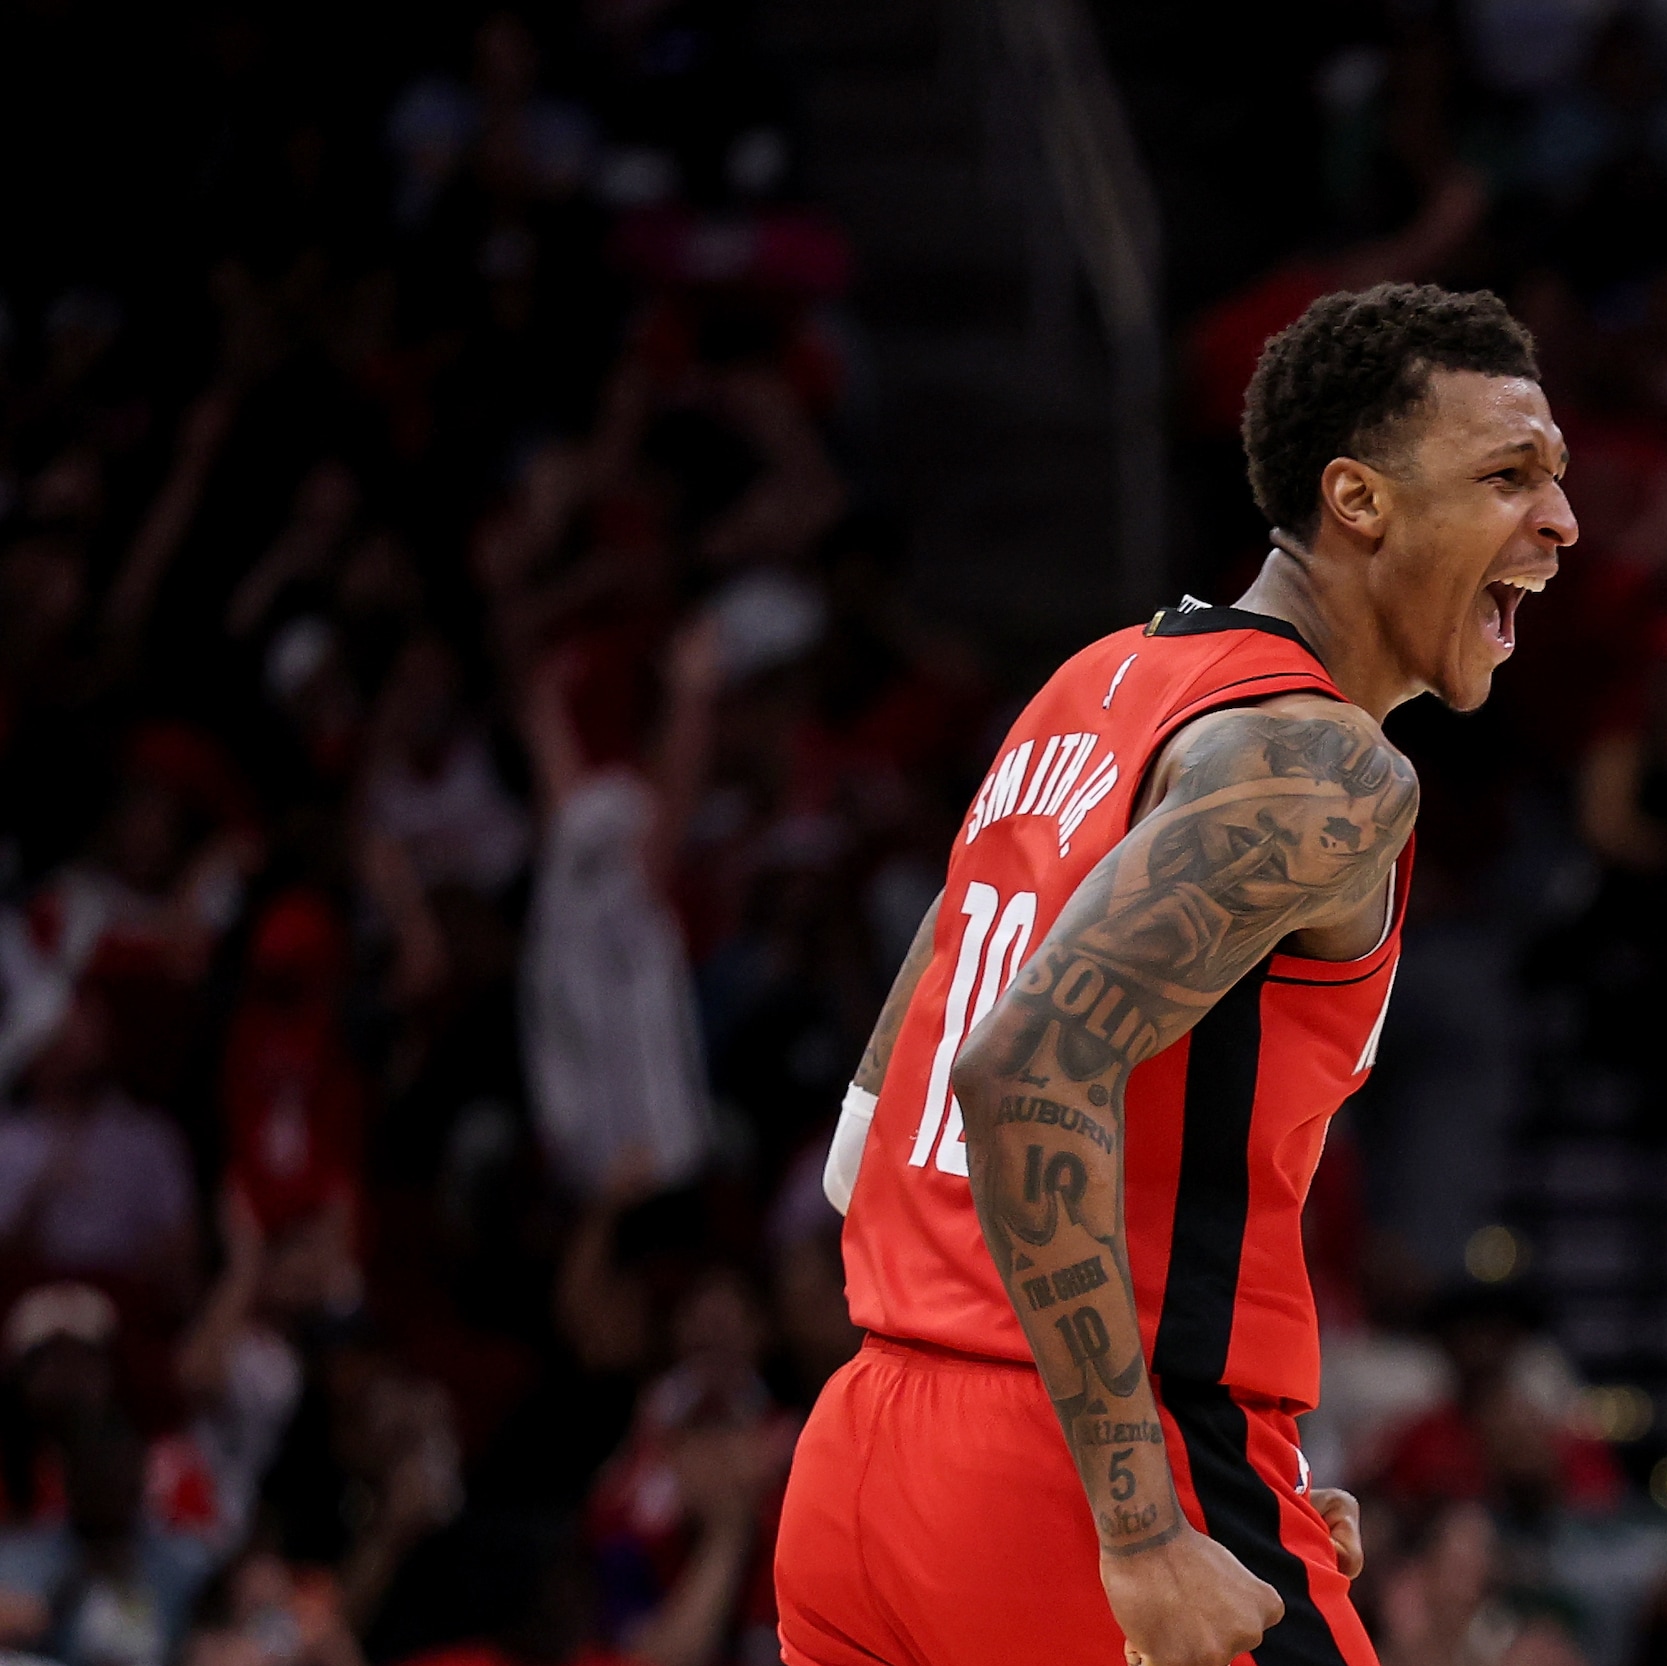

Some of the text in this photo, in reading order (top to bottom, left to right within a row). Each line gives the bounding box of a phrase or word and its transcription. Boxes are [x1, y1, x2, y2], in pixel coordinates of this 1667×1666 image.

[965, 732, 1099, 845] SMITH
[998, 1096, 1114, 1155] AUBURN
[1055, 1305, 1112, 1367] 10
[1108, 1448, 1137, 1501] 5
